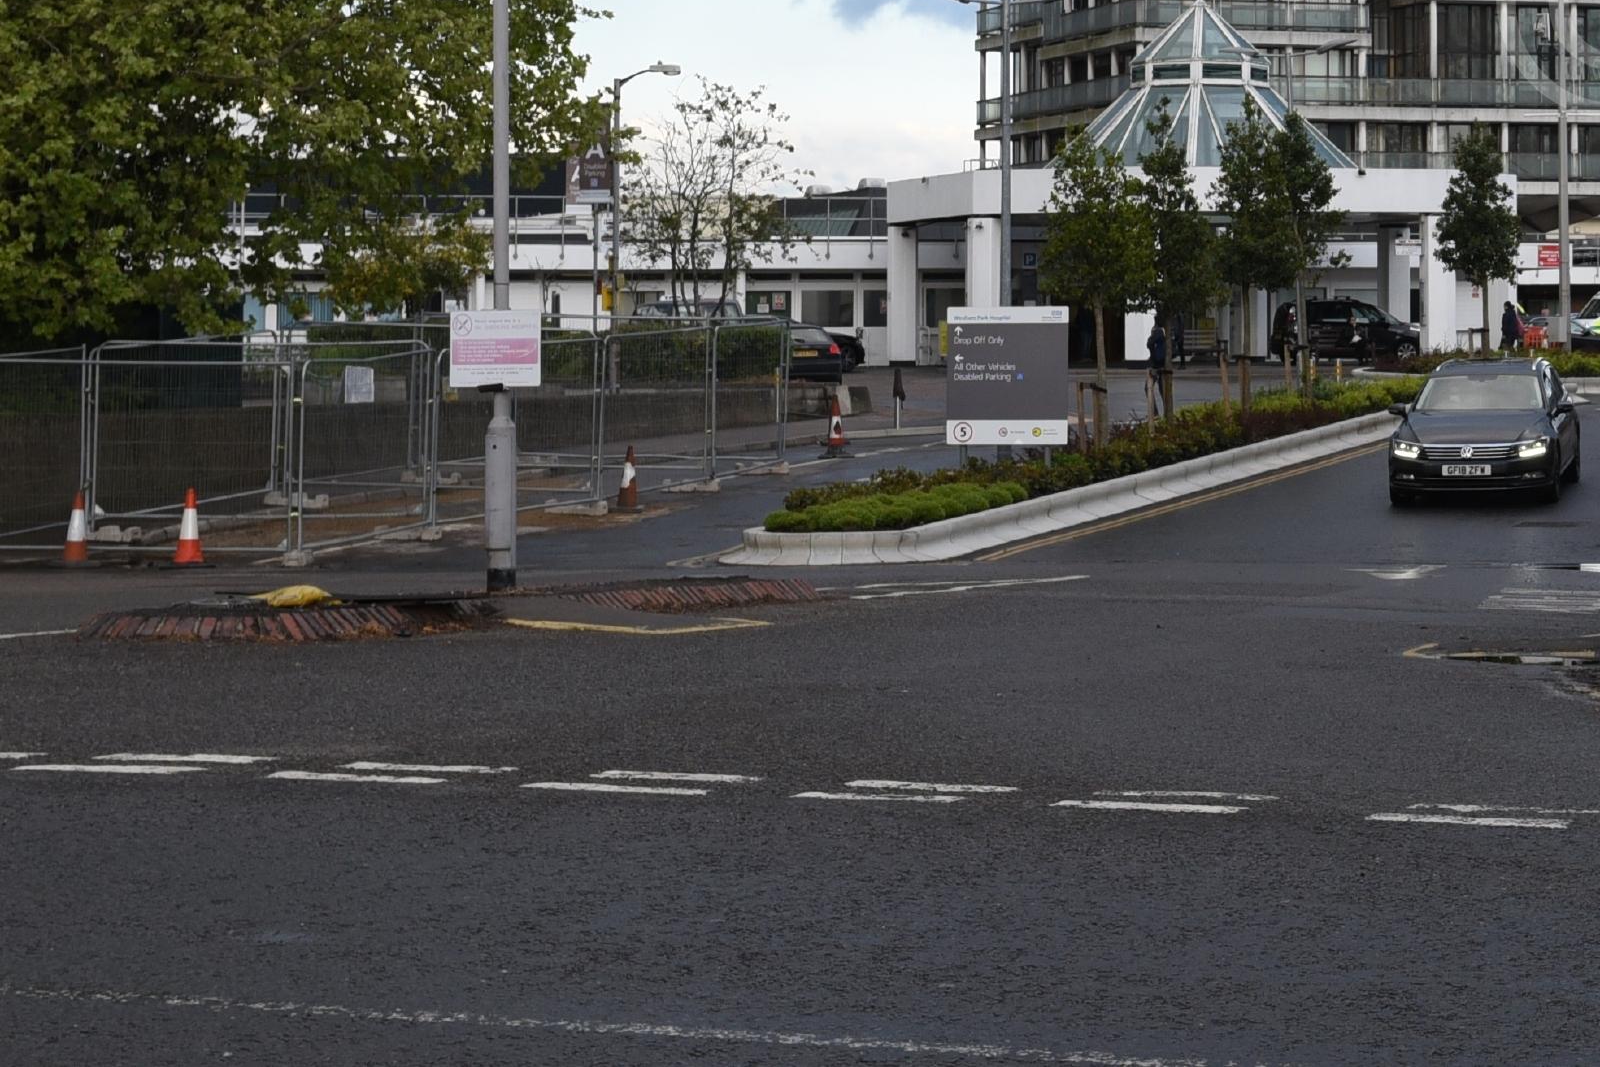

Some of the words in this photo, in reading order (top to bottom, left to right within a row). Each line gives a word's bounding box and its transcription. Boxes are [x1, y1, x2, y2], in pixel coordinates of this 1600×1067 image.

[954, 336, 972, 346] Drop
[973, 335, 986, 345] Off
[988, 335, 1004, 347] Only
[954, 362, 964, 371] All
[965, 362, 986, 371] Other
[987, 362, 1016, 371] Vehicles
[954, 372, 984, 381] Disabled
[985, 372, 1012, 383] Parking
[959, 426, 967, 437] 5
